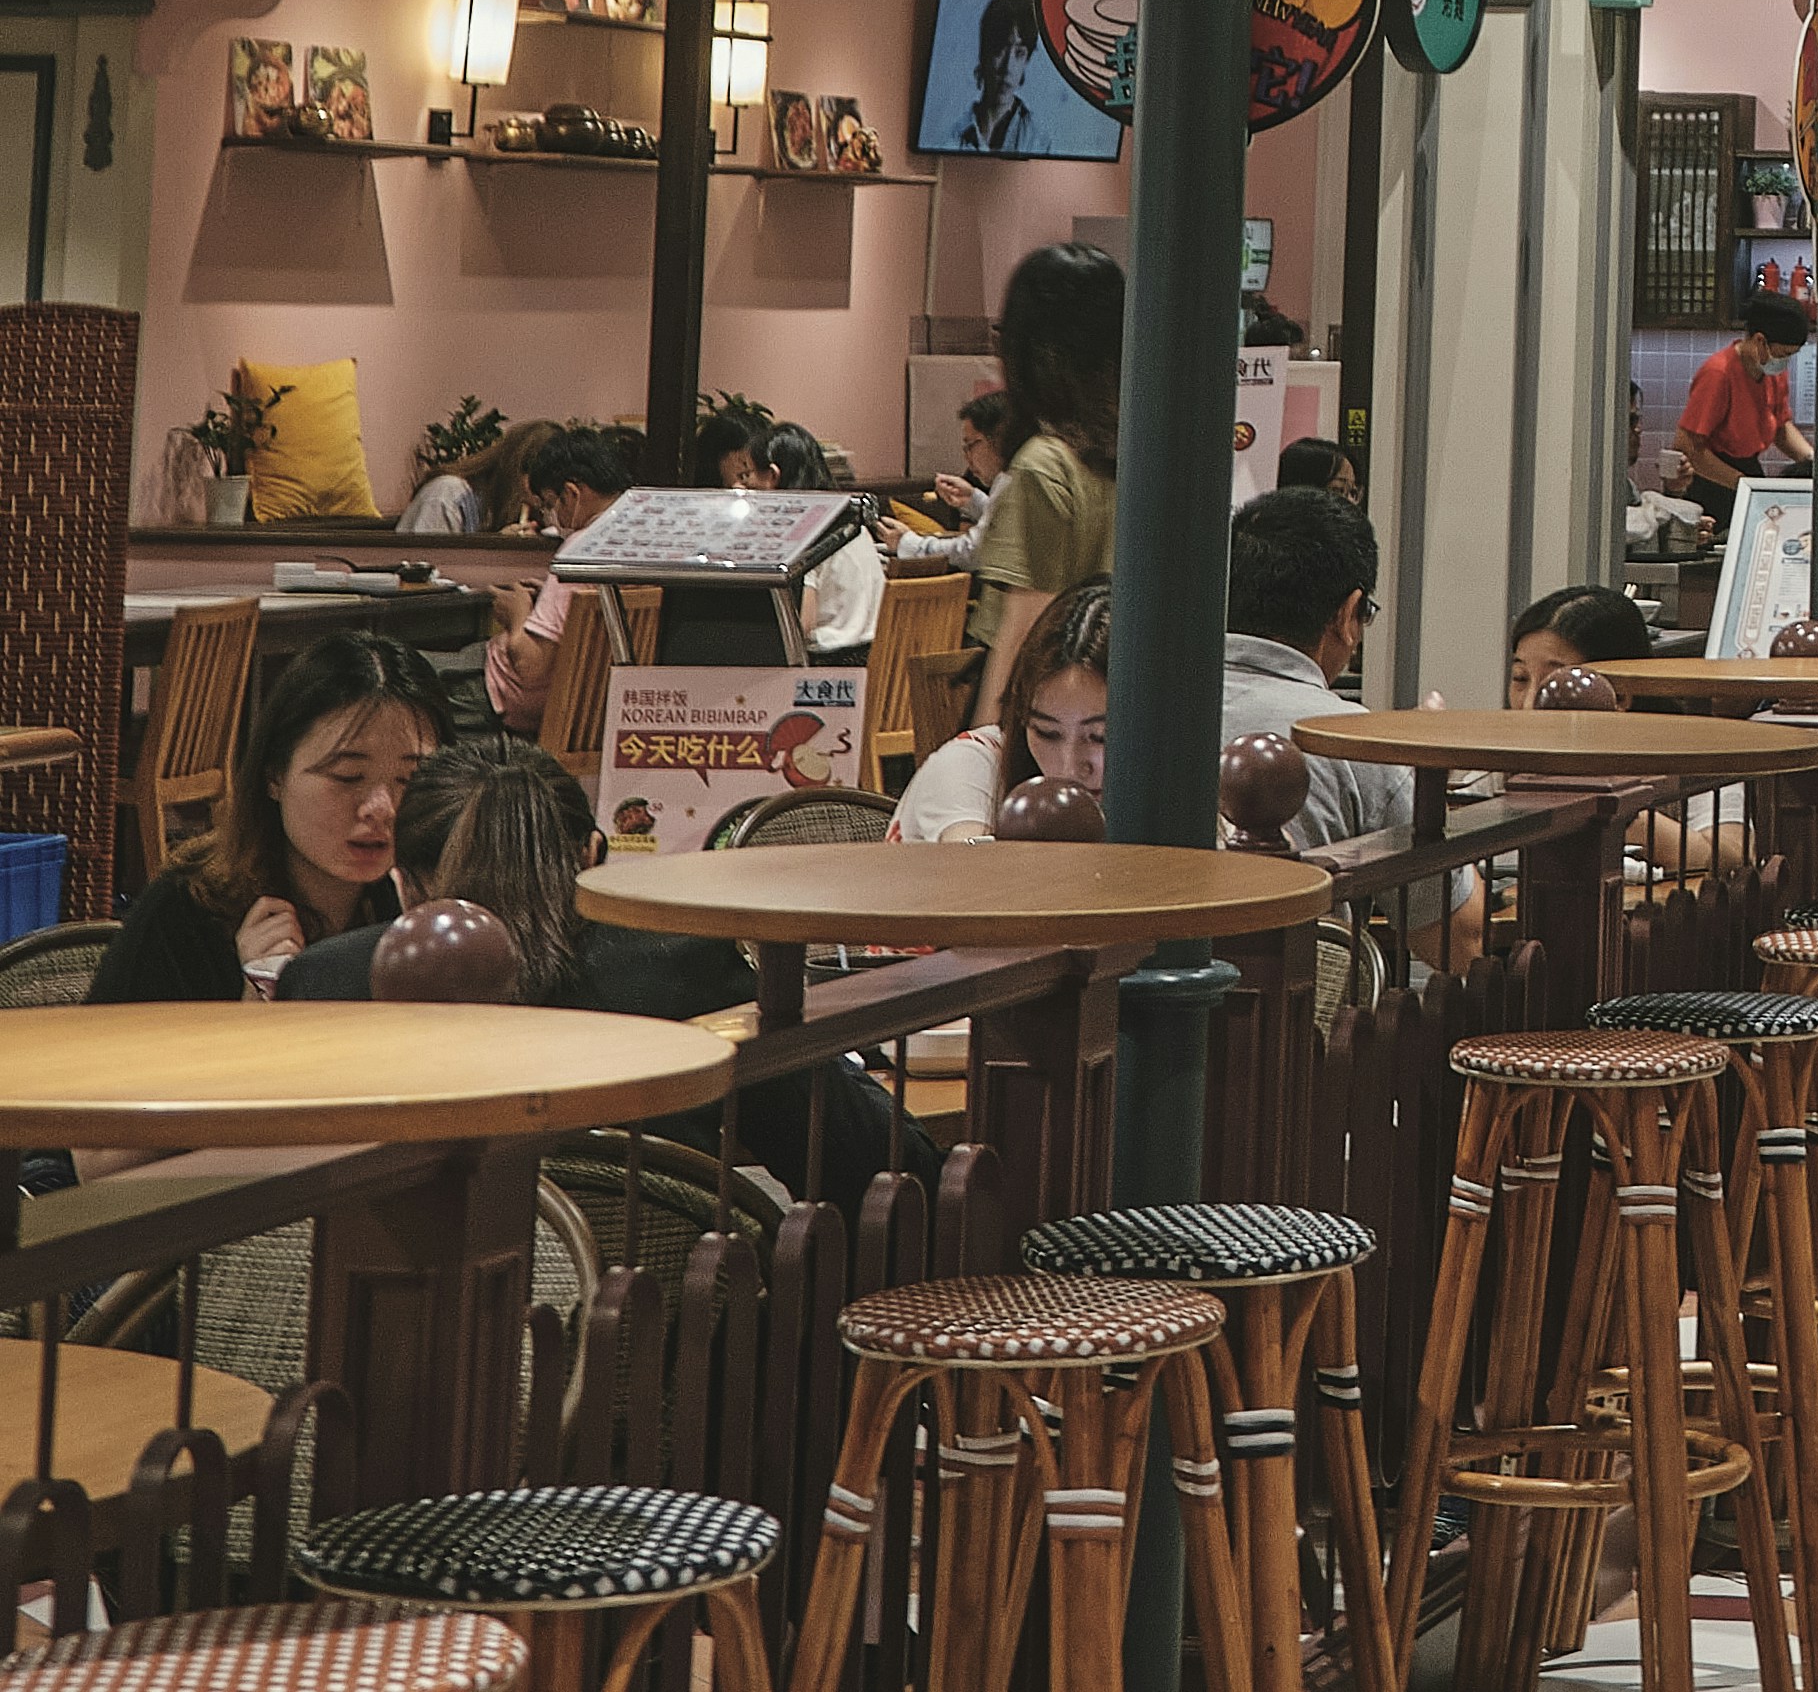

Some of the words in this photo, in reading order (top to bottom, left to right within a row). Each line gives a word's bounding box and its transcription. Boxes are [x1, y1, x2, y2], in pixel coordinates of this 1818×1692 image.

[796, 679, 854, 700] 大食代
[621, 708, 686, 724] KOREAN
[691, 709, 768, 724] BIBIMBAP
[619, 733, 764, 767] 今天吃什么
